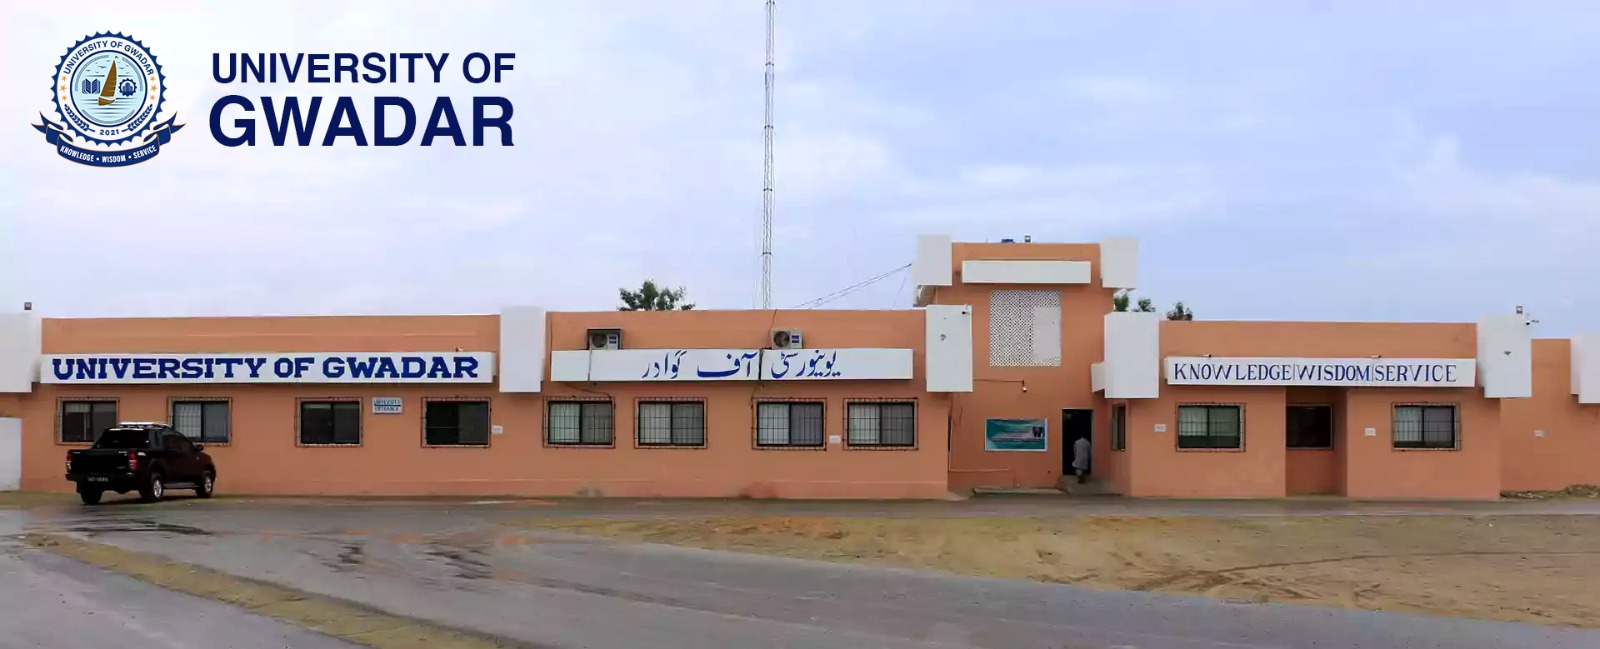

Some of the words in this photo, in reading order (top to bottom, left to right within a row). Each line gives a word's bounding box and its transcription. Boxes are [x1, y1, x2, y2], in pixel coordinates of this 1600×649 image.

[52, 356, 267, 381] UNIVERSITY
[273, 357, 316, 379] OF
[322, 356, 480, 380] GWADAR
[641, 350, 688, 379] گوادر
[697, 351, 758, 379] آف
[771, 350, 841, 379] یونیورسٹی
[1173, 363, 1292, 381] KNOWLEDGE
[1296, 364, 1371, 382] WISDOM
[1375, 364, 1457, 382] SERVICE
